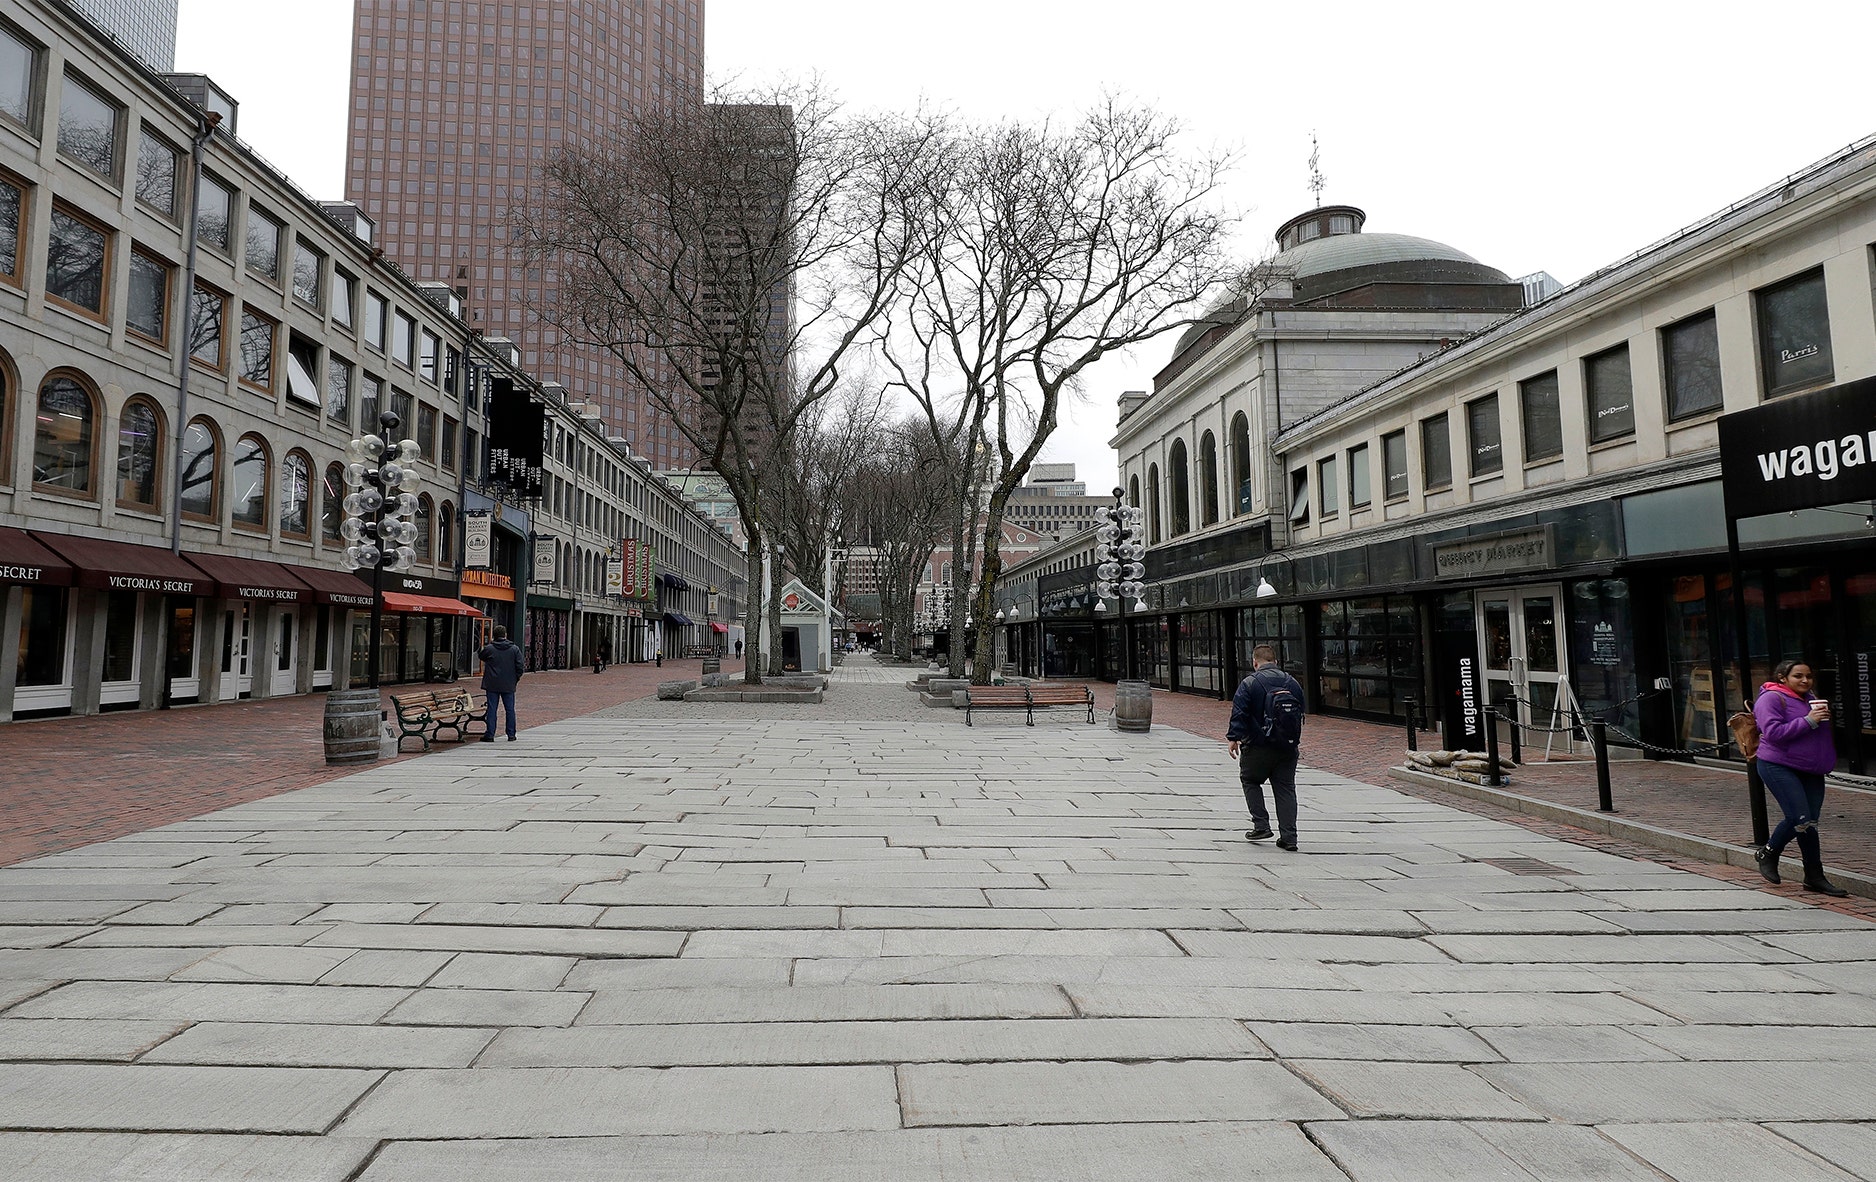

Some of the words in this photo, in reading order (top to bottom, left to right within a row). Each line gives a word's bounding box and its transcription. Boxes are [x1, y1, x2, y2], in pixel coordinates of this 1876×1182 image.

[1781, 344, 1818, 361] Parris
[1757, 430, 1876, 481] waga
[1438, 549, 1482, 567] QUINCY
[1486, 540, 1544, 560] MARKET
[622, 540, 635, 595] CHRISTMAS
[109, 576, 161, 590] VICTORIA'S
[162, 581, 194, 593] SECRET
[462, 570, 480, 583] URBAN
[481, 571, 511, 588] OUTFITTERS
[608, 573, 621, 587] 2
[239, 587, 275, 598] VICTORIA'S
[276, 589, 298, 600] SECRET
[329, 593, 357, 604] VICTORIA'S
[1460, 657, 1478, 736] wagamama
